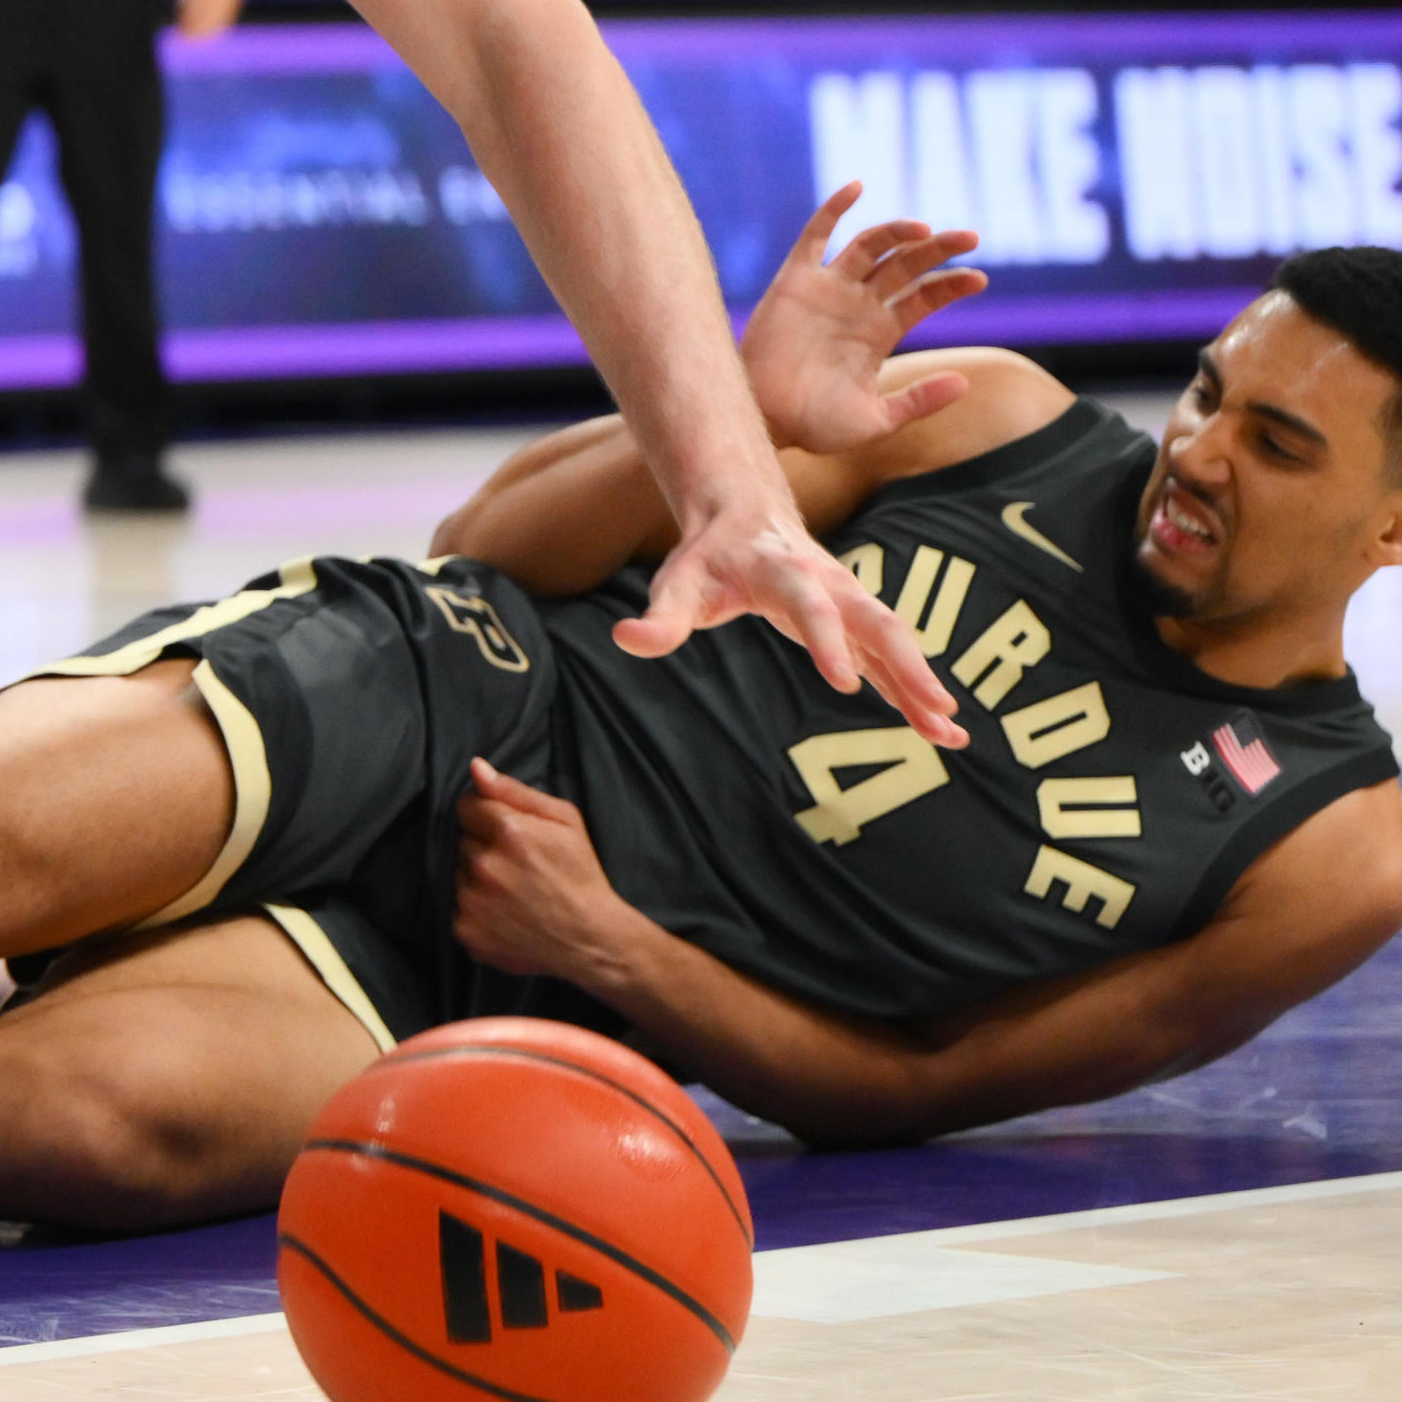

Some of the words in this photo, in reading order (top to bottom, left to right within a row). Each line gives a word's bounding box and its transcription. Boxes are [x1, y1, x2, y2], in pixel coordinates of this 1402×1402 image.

[809, 67, 1110, 266] MAKE
[1113, 63, 1402, 263] NOISE
[788, 724, 950, 847] 4
